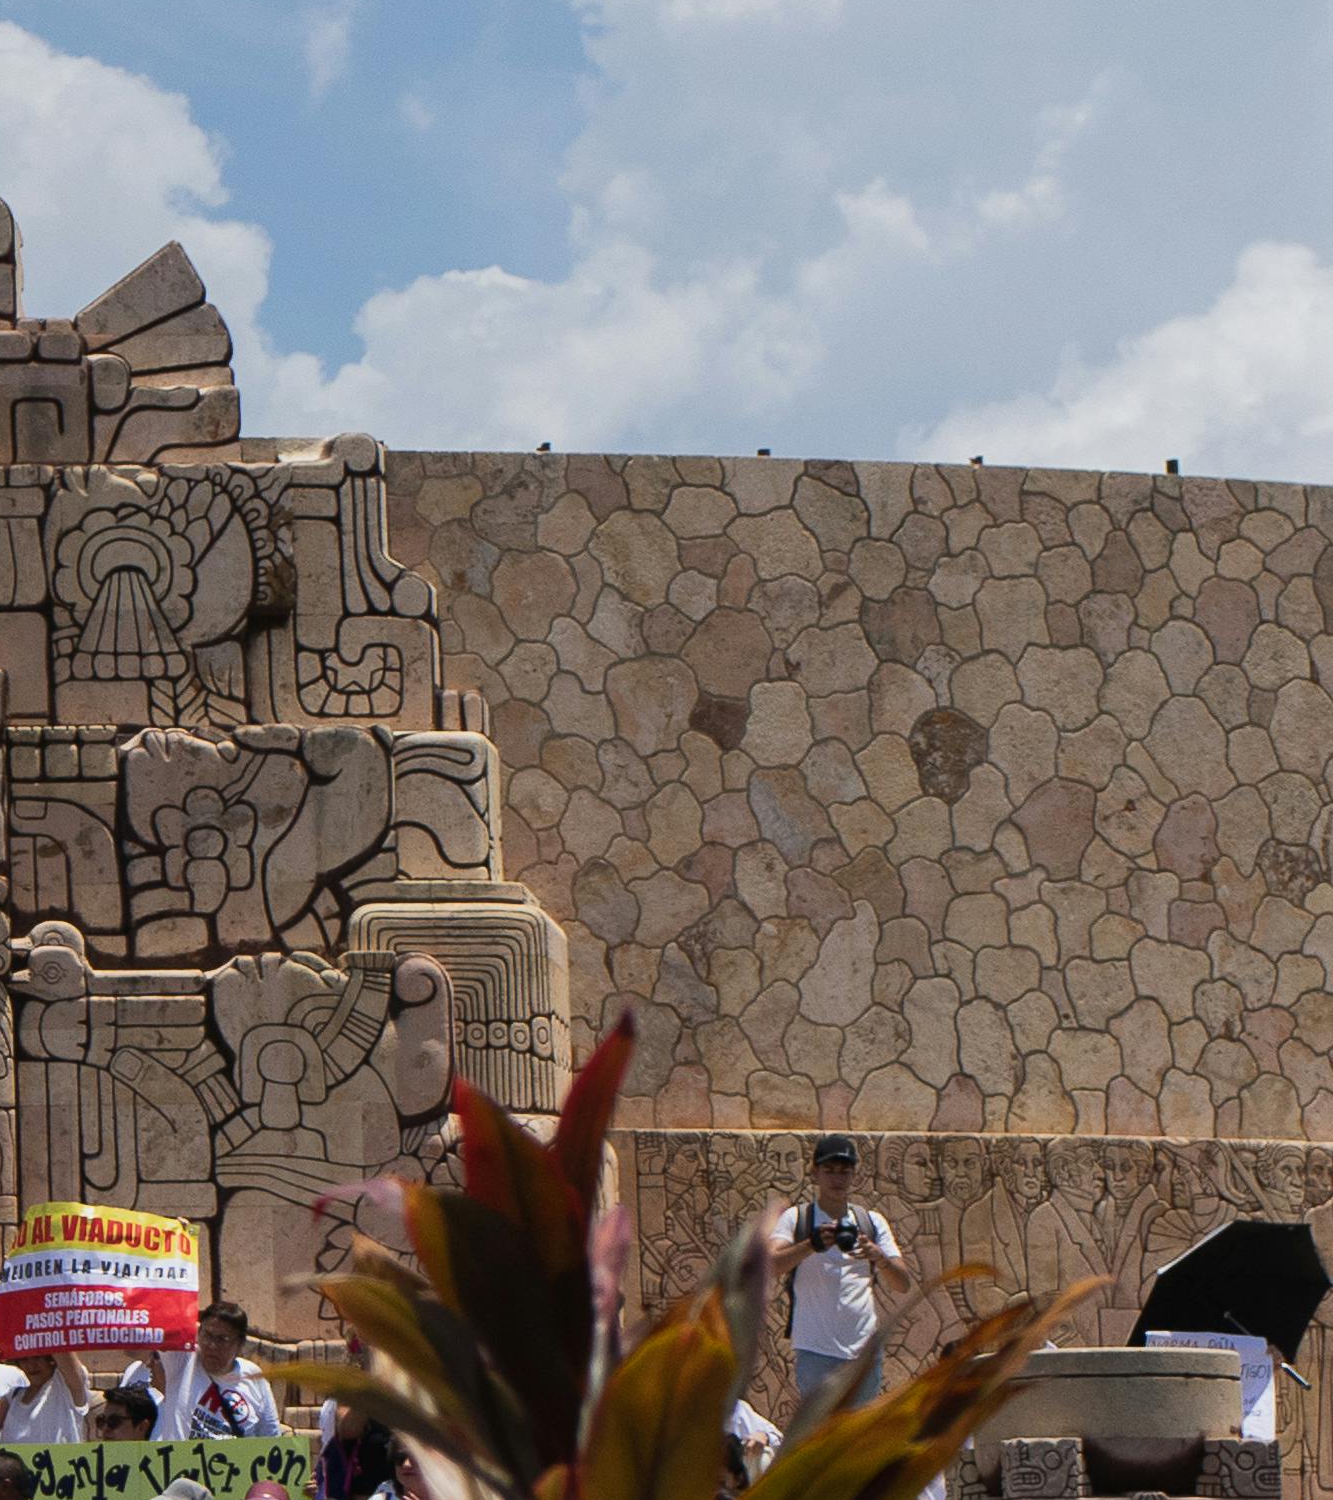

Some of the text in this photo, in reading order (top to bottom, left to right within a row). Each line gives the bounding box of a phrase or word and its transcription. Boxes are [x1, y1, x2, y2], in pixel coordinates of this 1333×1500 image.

[31, 1215, 55, 1246] AL
[61, 1215, 191, 1256] VIADUCTO
[71, 1258, 92, 1274] LA
[25, 1309, 149, 1330] PASOS PEATONALES
[14, 1327, 164, 1350] CONTROL DE VELOCIDAD
